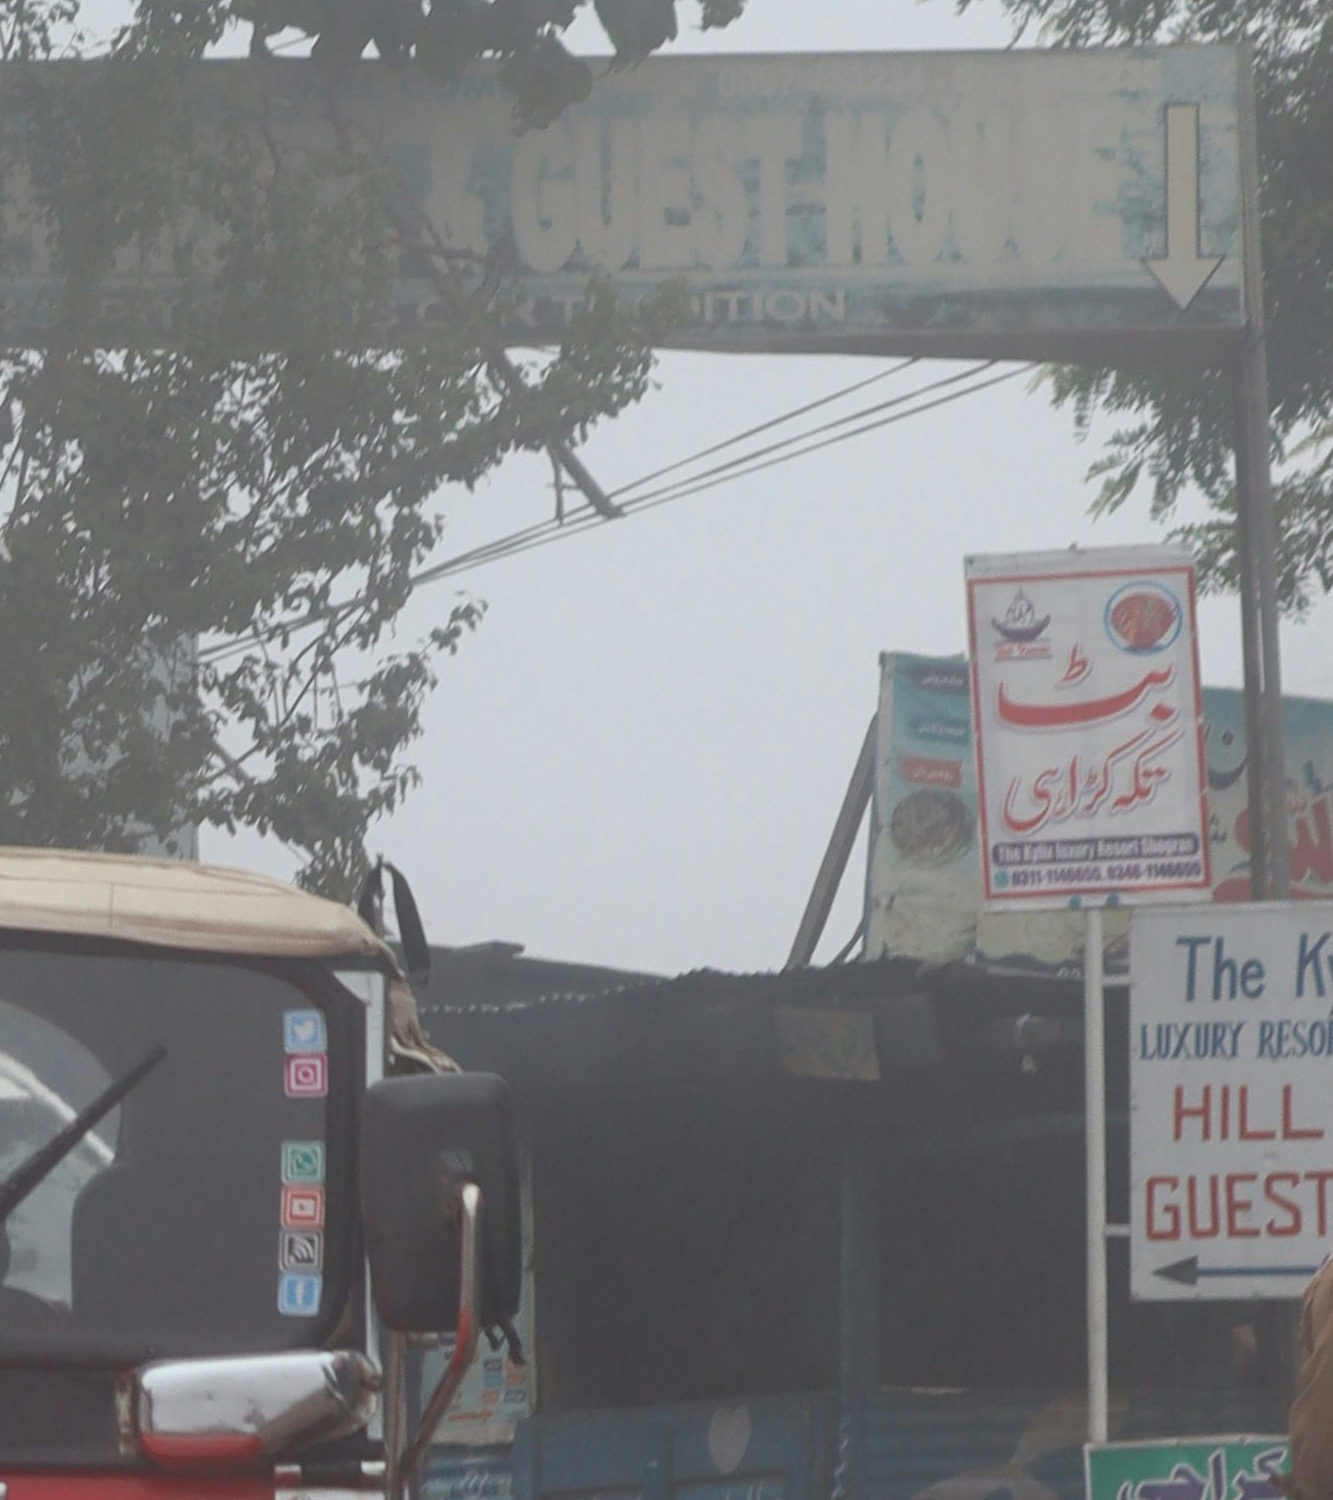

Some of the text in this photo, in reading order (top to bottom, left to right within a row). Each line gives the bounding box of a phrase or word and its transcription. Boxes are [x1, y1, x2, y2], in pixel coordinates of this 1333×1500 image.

[512, 116, 802, 272] GUEST
[552, 289, 846, 327] TITION
[1174, 931, 1333, 1020] The K
[1138, 1020, 1246, 1063] LUXURY
[1172, 1082, 1326, 1143] HILL
[1145, 1169, 1333, 1243] GUEST
